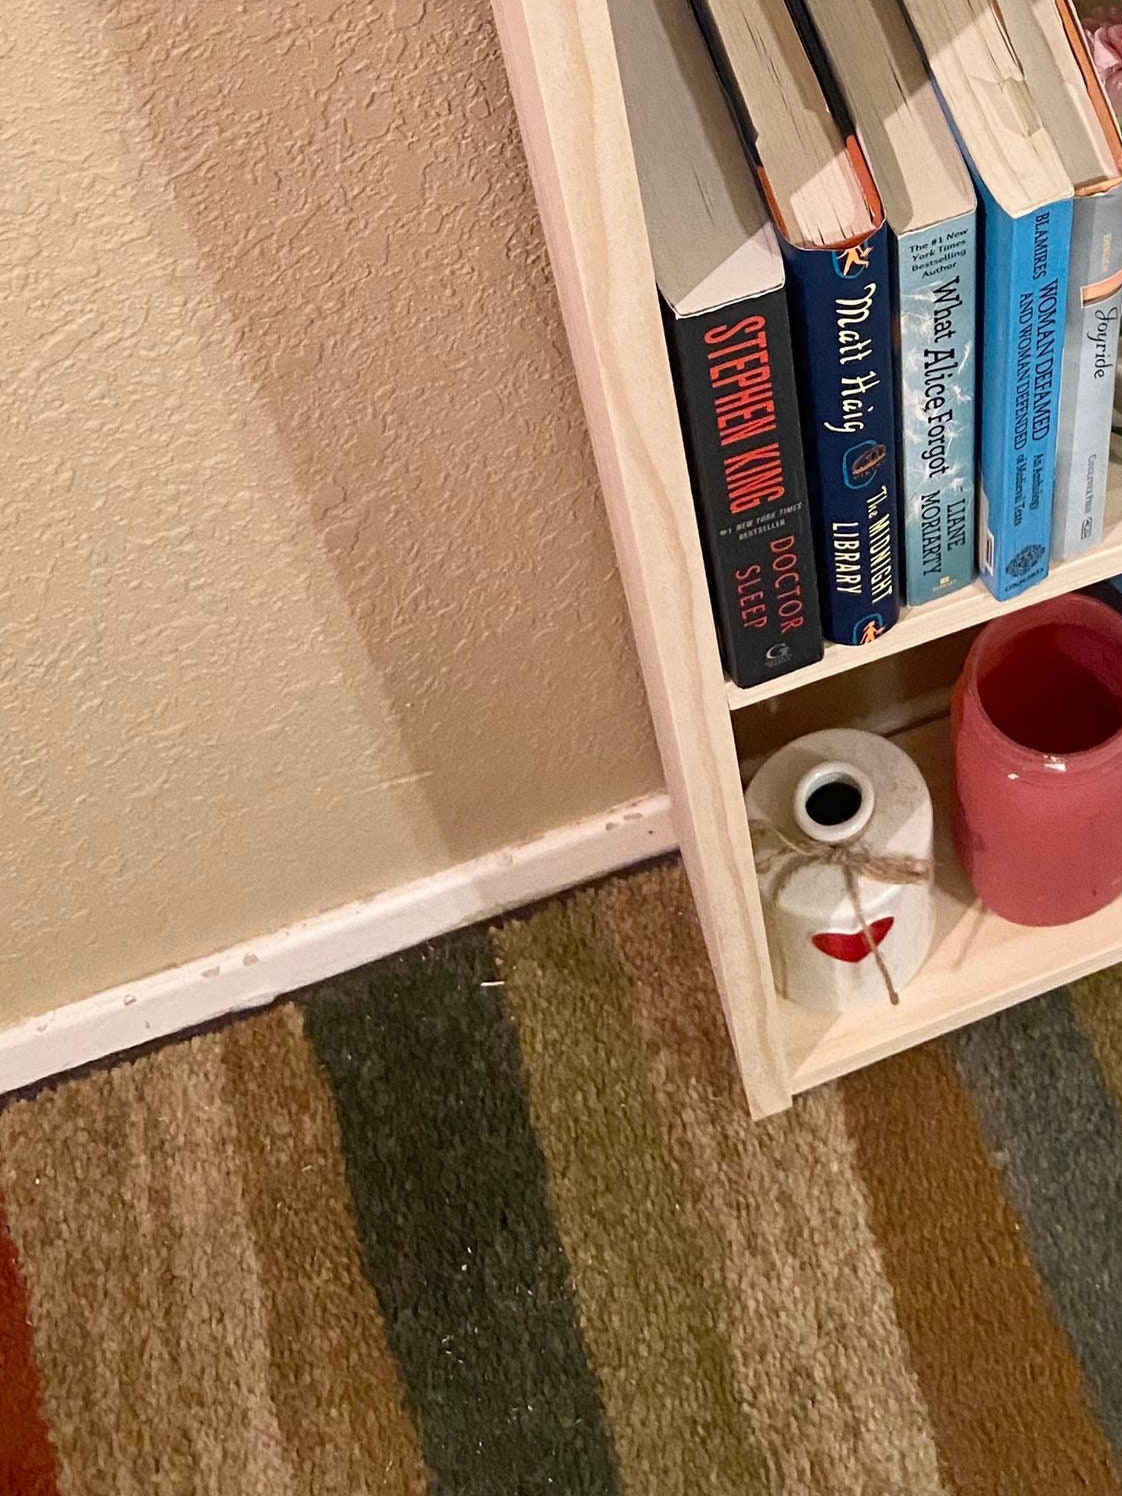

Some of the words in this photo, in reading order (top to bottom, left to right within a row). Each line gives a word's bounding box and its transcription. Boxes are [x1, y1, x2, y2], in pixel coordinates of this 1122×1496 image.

[909, 242, 929, 253] The
[946, 228, 969, 241] New
[911, 249, 936, 262] York
[938, 238, 966, 253] Times
[911, 248, 967, 272] Bestselling
[921, 261, 958, 279] Author
[1033, 210, 1050, 281] BLAMIRES
[835, 282, 877, 365] Matt
[933, 275, 963, 343] What
[1018, 291, 1034, 325] AND
[1036, 277, 1059, 358] WOMAN
[1016, 322, 1033, 383] WOMAN
[1087, 306, 1118, 379] Joyride
[703, 315, 777, 447] STEPHEN
[823, 370, 881, 433] Haig
[923, 348, 959, 413] Alice
[1031, 356, 1054, 441] DEFAMED
[921, 409, 950, 478] Forgot
[1014, 380, 1031, 451] DEFENDED
[723, 442, 785, 515] KING
[866, 485, 888, 519] The
[736, 519, 754, 532] NEW
[756, 511, 777, 524] YORK
[779, 501, 803, 516] TIMES
[738, 518, 786, 540] BESTSELLER
[921, 490, 942, 576] MORIARTY
[946, 498, 966, 551] LIANE
[770, 534, 805, 635] DOCTOR
[832, 522, 862, 594] LIBRARY
[868, 513, 893, 604] MIDNIGHT
[735, 564, 768, 628] SLEEP
